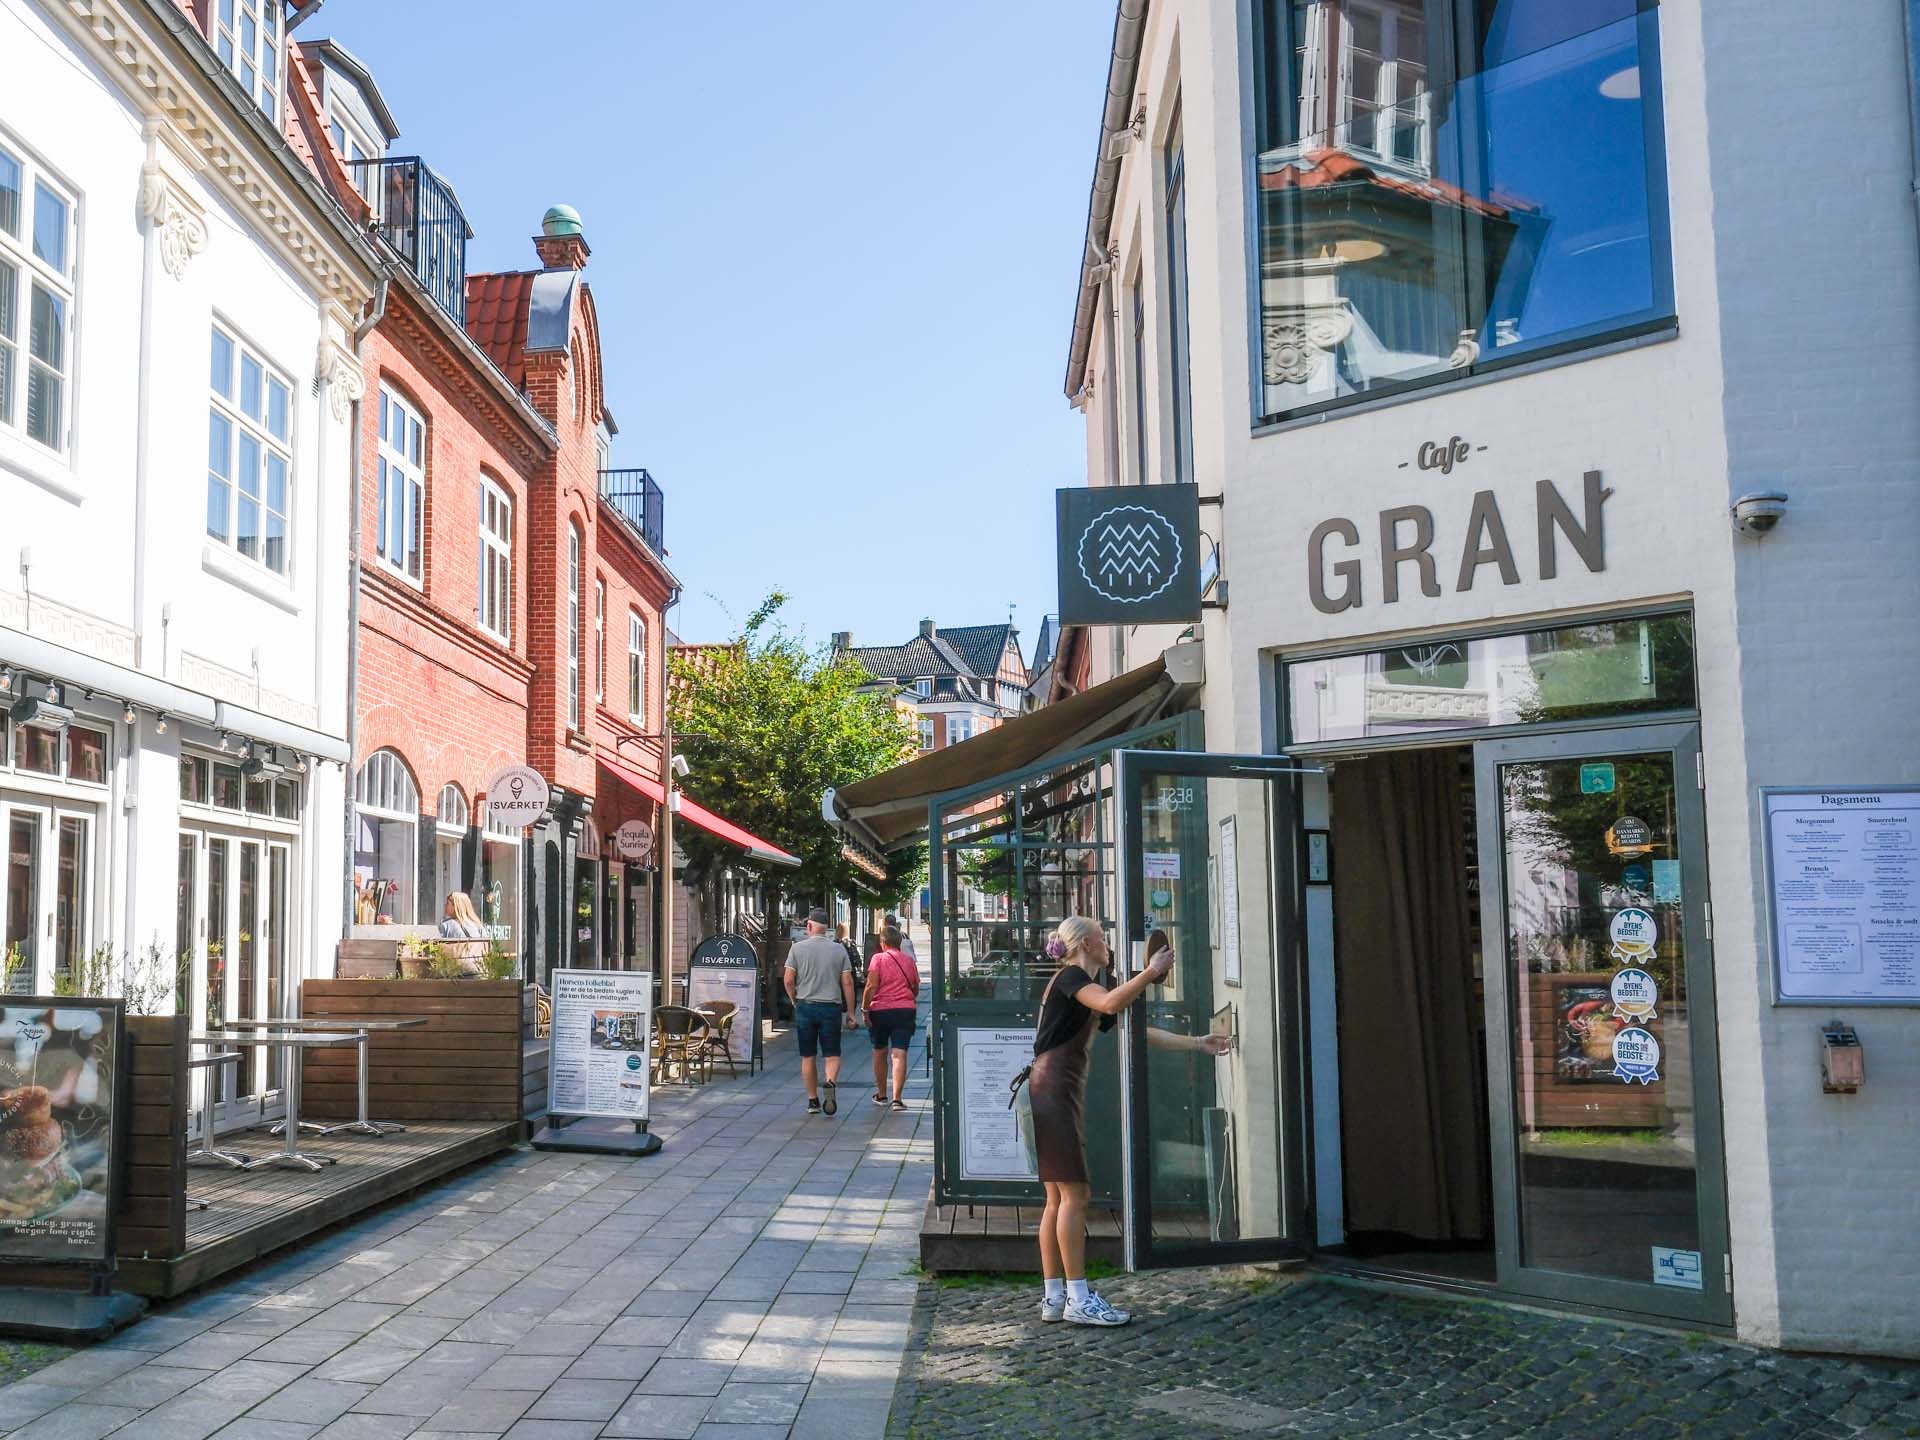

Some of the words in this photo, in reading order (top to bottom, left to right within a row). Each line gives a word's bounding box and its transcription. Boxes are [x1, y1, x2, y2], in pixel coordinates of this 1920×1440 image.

[1417, 436, 1470, 475] Cafe
[1307, 469, 1615, 615] GRAN
[1820, 794, 1882, 806] Dagsmenu
[490, 801, 545, 810] ISVÆRKET
[620, 828, 650, 841] Tequila
[620, 839, 650, 849] Sunrise
[1624, 922, 1643, 930] BYENS
[1617, 928, 1639, 937] BEDSTE
[702, 956, 747, 965] ISVÆRKET
[559, 978, 585, 986] Horsens
[585, 979, 616, 987] Folkeblad
[1623, 982, 1643, 990] BYENS
[1617, 989, 1640, 997] BEDSTE
[995, 1033, 1034, 1041] Dagsmenu
[1617, 1041, 1640, 1051] BYENS
[1617, 1050, 1643, 1061] BEDSTE
[29, 1218, 58, 1228] juicy,
[14, 1226, 47, 1236] burger
[49, 1227, 68, 1236] love
